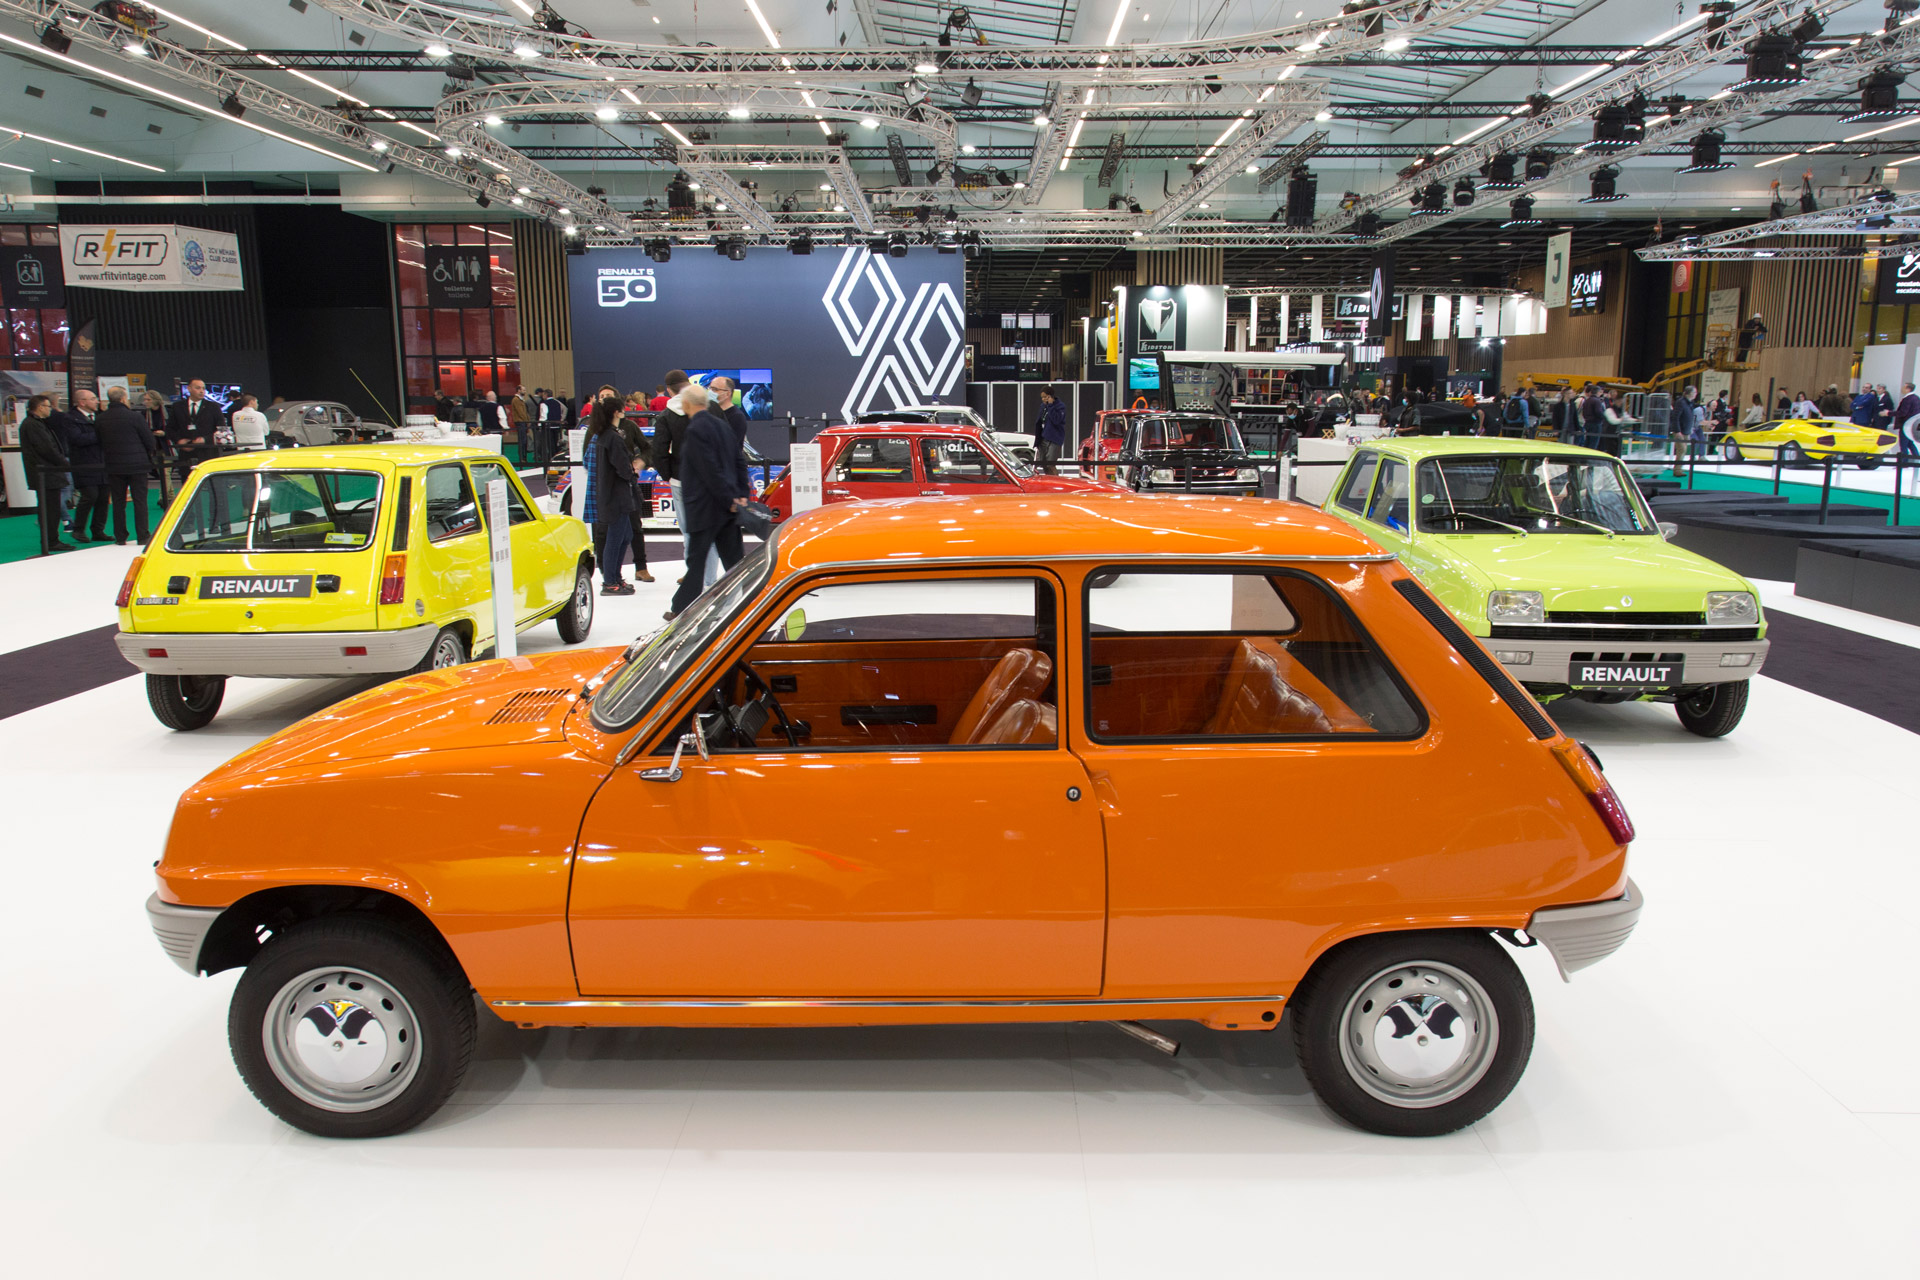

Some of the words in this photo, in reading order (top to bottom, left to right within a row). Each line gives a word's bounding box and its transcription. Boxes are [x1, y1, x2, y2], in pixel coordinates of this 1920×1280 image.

[83, 242, 99, 258] R
[117, 242, 159, 258] FIT
[598, 268, 646, 276] RENAULT
[646, 268, 655, 276] 5
[1552, 252, 1562, 284] J
[79, 271, 167, 283] www.rfitvintage.com
[601, 279, 653, 303] 50
[1140, 342, 1173, 352] KIDSTON
[211, 578, 300, 594] RENAULT
[1581, 667, 1671, 682] RENAULT
